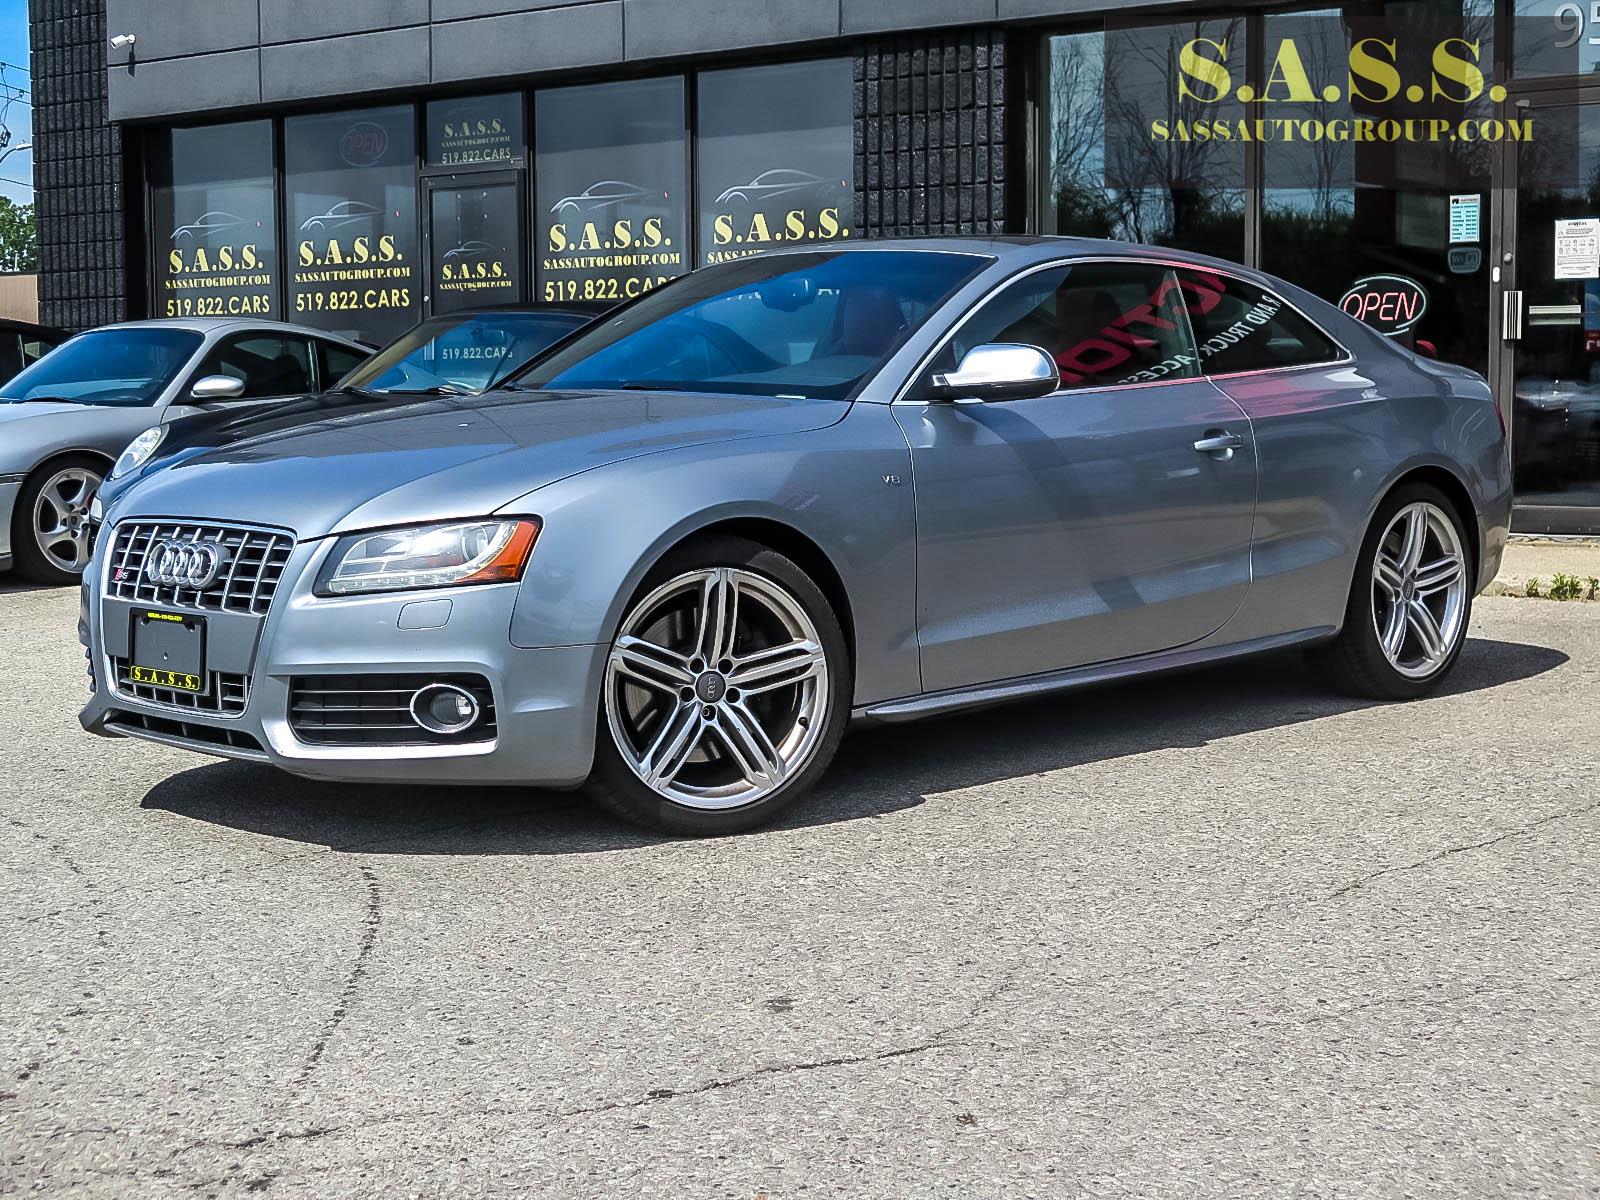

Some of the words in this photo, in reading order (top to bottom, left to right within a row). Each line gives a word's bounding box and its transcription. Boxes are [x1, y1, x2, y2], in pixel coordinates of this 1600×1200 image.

[444, 118, 506, 138] S.A.S.S.
[442, 148, 511, 164] 519.822.CARS
[549, 217, 672, 252] S.A.S.S.
[713, 207, 849, 245] S.A.S.S.
[169, 244, 264, 274] S.A.S.S.
[299, 235, 403, 267] S.A.S.S.
[543, 252, 681, 270] SASSAUTOGROUP.COM
[294, 266, 411, 283] SASSAUTOGROUP.COM
[442, 261, 507, 280] S.A.S.S.
[165, 274, 271, 289] SASSAUTOGROUP.COM
[439, 280, 512, 290] SASSAUTOGROUP.COM
[544, 276, 677, 302] 519.822.CA
[166, 295, 270, 317] 519.822.CARS
[296, 288, 410, 312] 519.822.CARS
[1343, 291, 1418, 321] OPEN
[134, 667, 196, 688] S.A.S.S.
